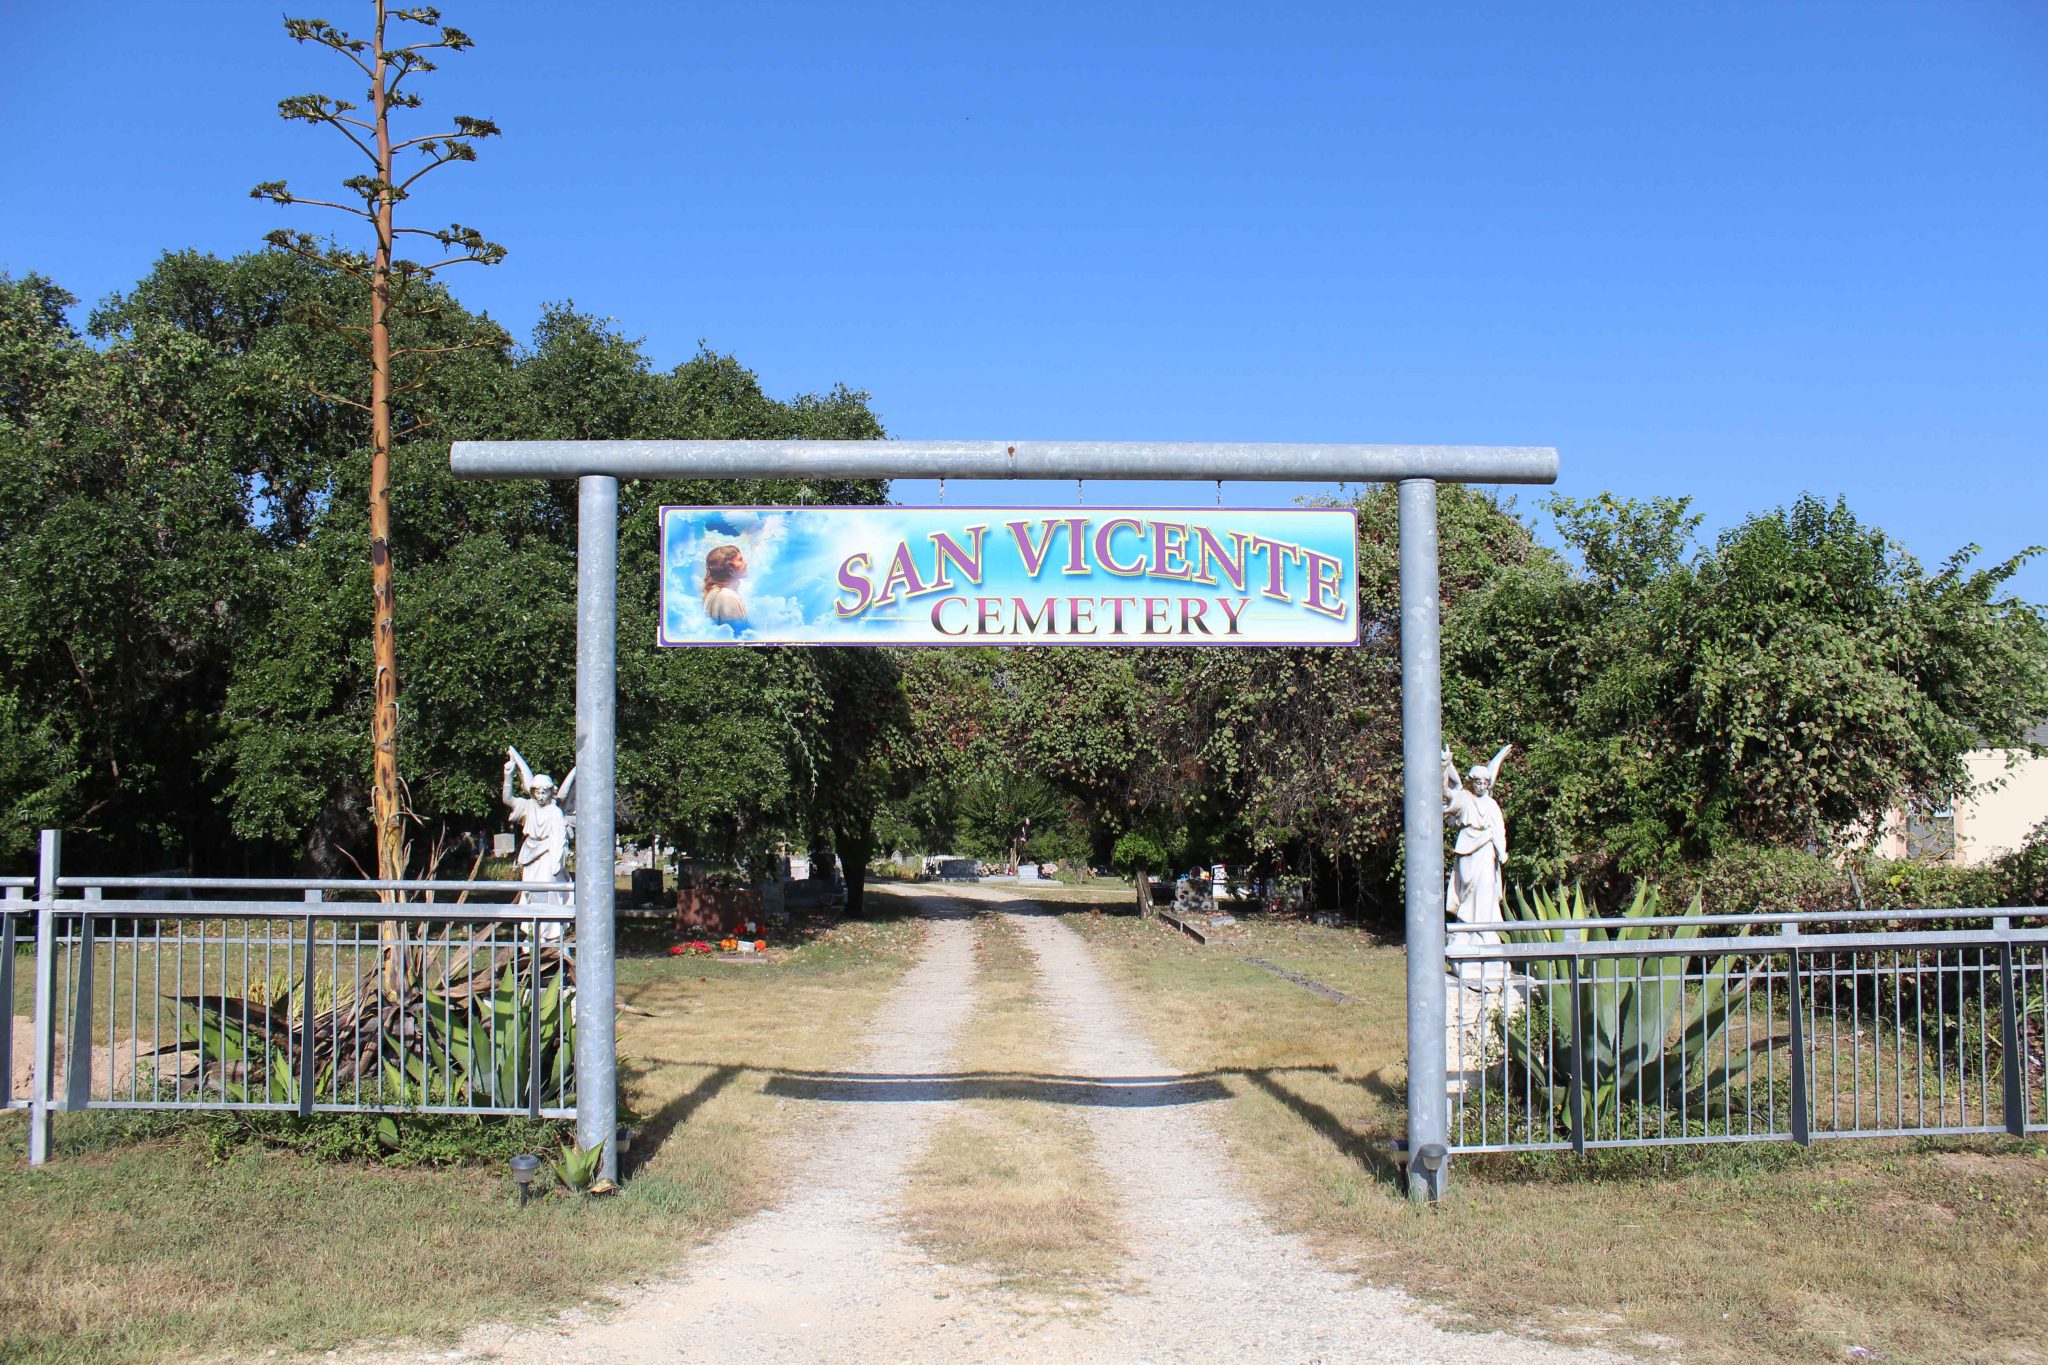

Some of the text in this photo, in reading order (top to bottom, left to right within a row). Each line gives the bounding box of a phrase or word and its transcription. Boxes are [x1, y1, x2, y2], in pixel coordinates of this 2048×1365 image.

[835, 518, 1345, 619] SAN VICENTE
[930, 596, 1253, 636] CEMETERY
